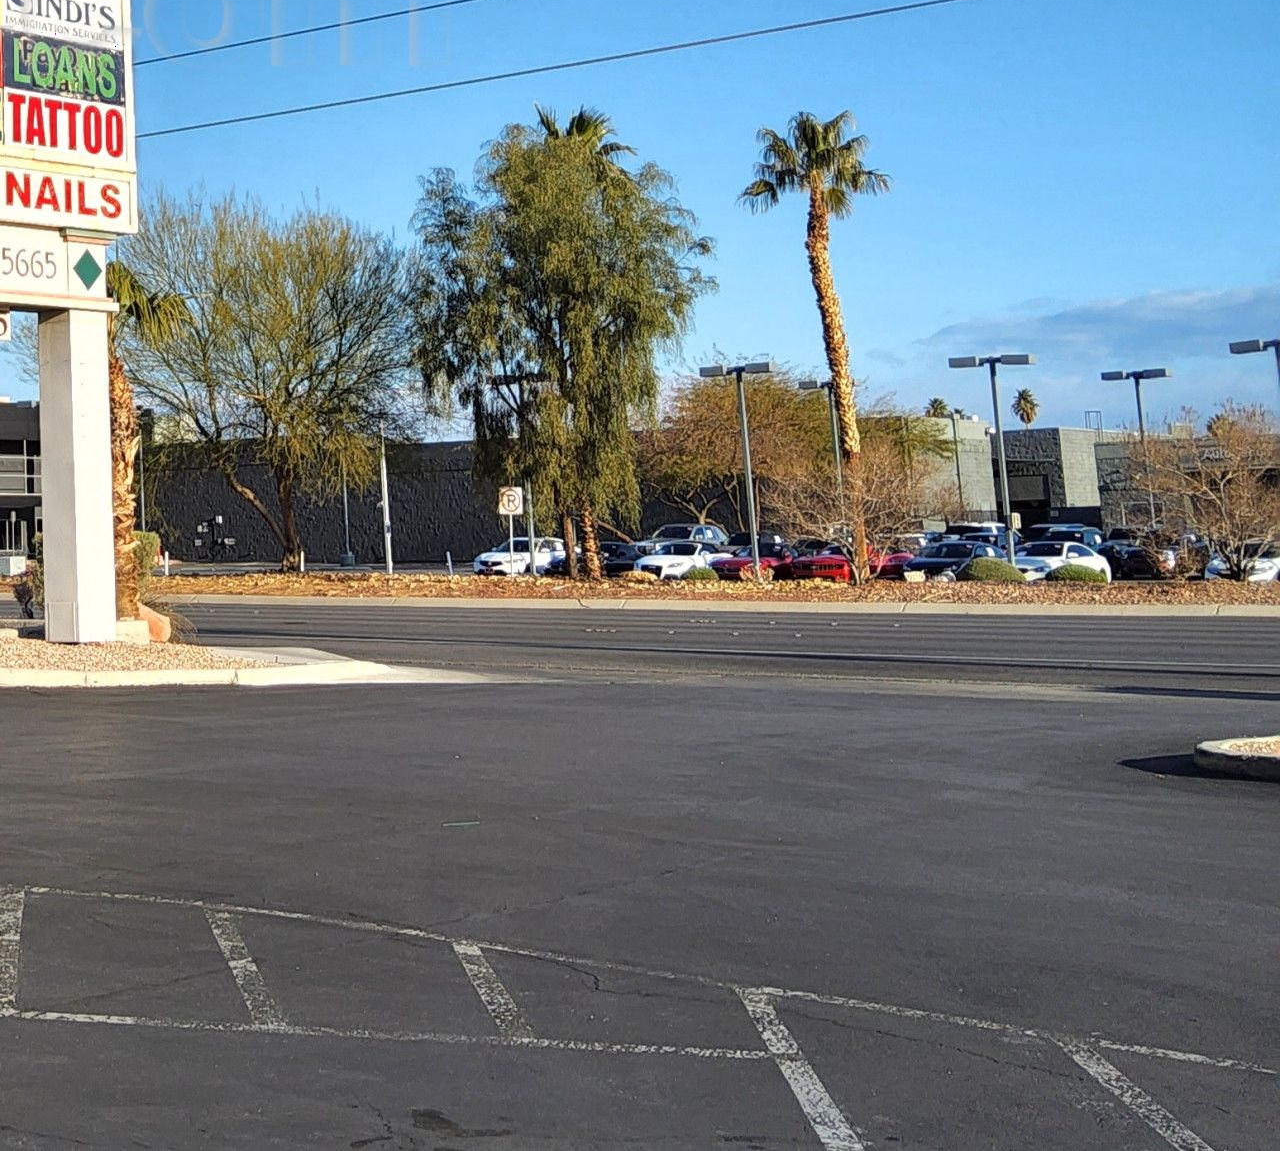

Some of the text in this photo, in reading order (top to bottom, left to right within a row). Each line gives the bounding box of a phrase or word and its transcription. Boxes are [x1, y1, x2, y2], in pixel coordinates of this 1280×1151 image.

[13, 37, 117, 99] LOANS
[7, 92, 124, 158] TATTOO
[5, 170, 122, 219] NAILS
